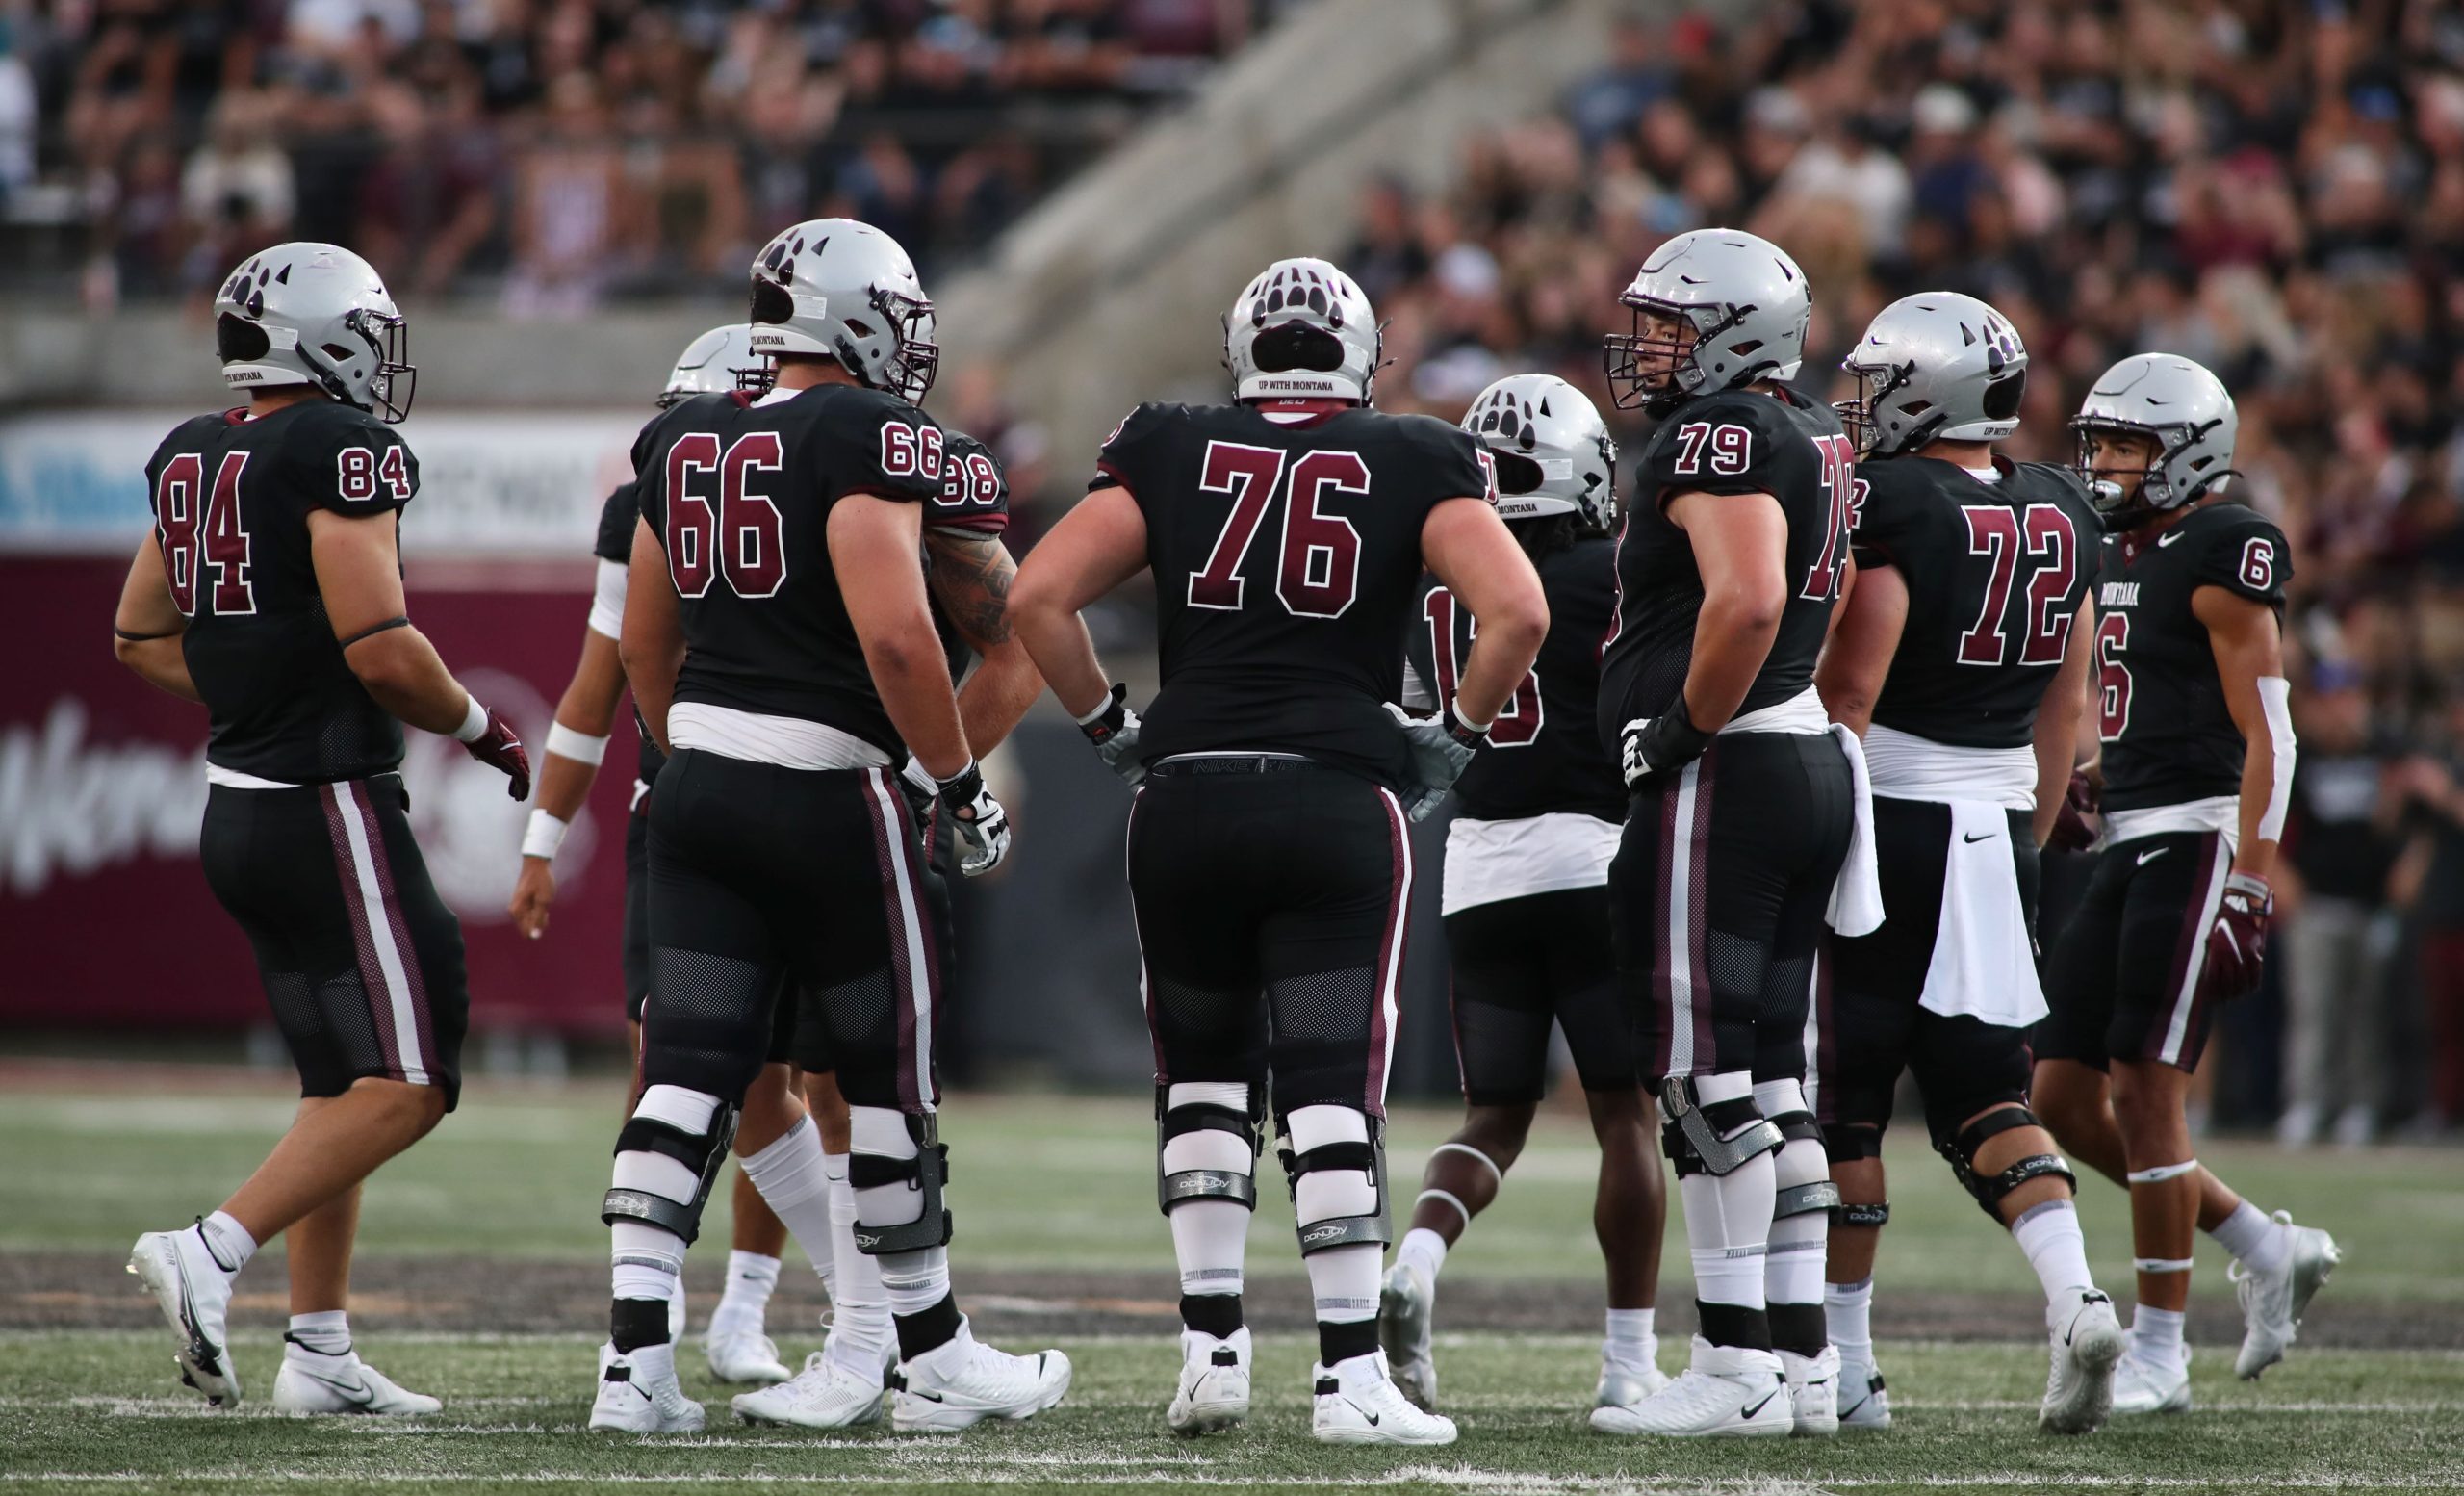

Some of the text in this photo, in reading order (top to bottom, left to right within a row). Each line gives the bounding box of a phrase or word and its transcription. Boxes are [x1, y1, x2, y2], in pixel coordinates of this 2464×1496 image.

[757, 335, 785, 346] MONTANA
[231, 372, 264, 383] MONTANA
[1259, 381, 1333, 392] UP WITH MONTANA
[880, 421, 943, 480] 66
[1674, 422, 1752, 475] 79
[1984, 427, 1994, 436] UP
[337, 445, 411, 501] 84
[1476, 447, 1500, 503] 7
[157, 450, 257, 617] 84
[666, 431, 786, 599] 66
[1187, 440, 1371, 619] 76
[1497, 503, 1538, 514] MONTANA
[1956, 503, 2077, 666] 72
[2239, 537, 2274, 590] 6
[2100, 582, 2140, 606] MONTANA
[2094, 611, 2132, 742] 6
[1193, 759, 1252, 774] NIKE
[1304, 1226, 1348, 1242] DONJOY
